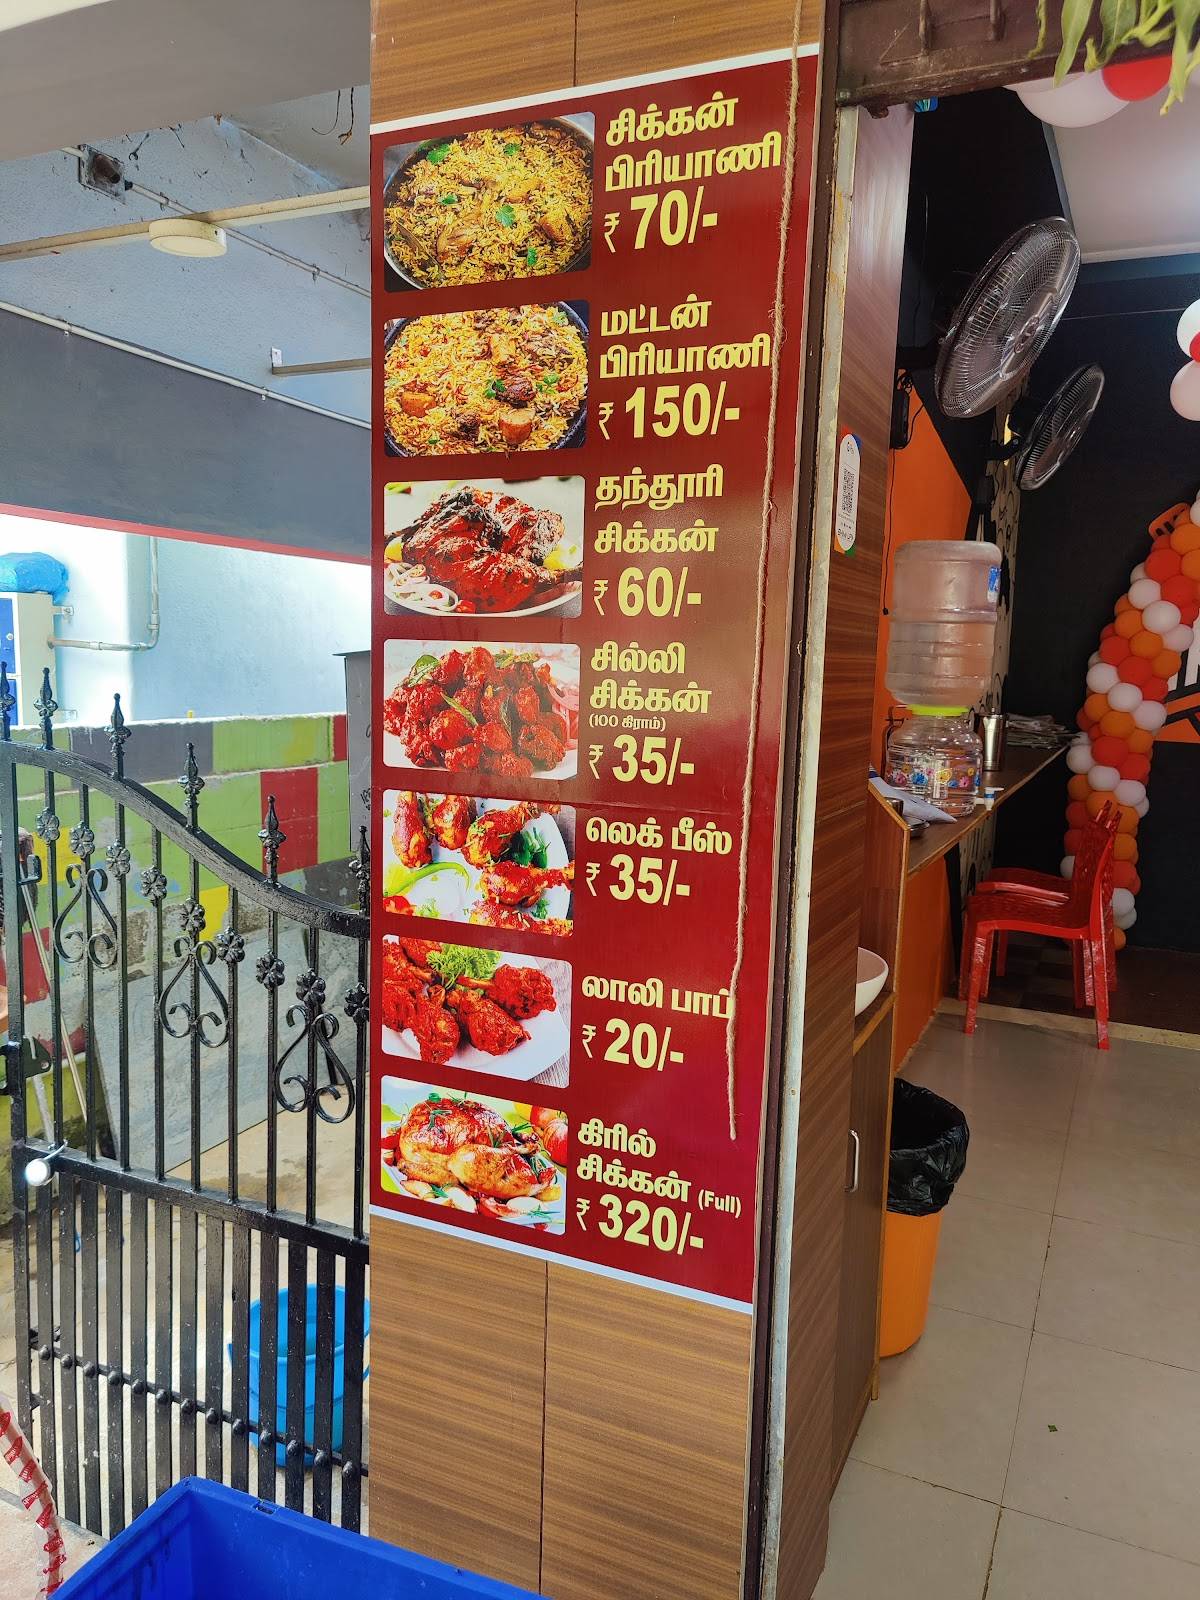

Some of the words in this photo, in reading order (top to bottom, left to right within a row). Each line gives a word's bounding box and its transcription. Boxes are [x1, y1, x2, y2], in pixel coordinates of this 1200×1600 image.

[606, 91, 738, 146] சிக்கன்
[605, 131, 782, 192] பிரியாணி
[630, 185, 718, 250] 70/-
[600, 293, 712, 337] மட்டன்
[599, 333, 771, 379] பிரியாணி
[625, 380, 740, 438] 150/-
[594, 463, 724, 512] தந்தூரி
[594, 518, 719, 553] சிக்கன்
[617, 566, 702, 617] 60/-
[590, 640, 686, 674] சில்லி
[589, 678, 712, 713] சிக்கன்
[611, 733, 695, 786] 35/-
[586, 816, 664, 848] லெக்
[671, 816, 733, 855] பீஸ்
[609, 853, 691, 906] 35/-
[581, 975, 664, 1008] லாலி
[603, 1017, 684, 1072] 20/-
[577, 1117, 657, 1158] கிரில்
[576, 1153, 692, 1203] சிக்கன்
[697, 1188, 742, 1219] (Full)
[598, 1193, 704, 1256] 320/-
